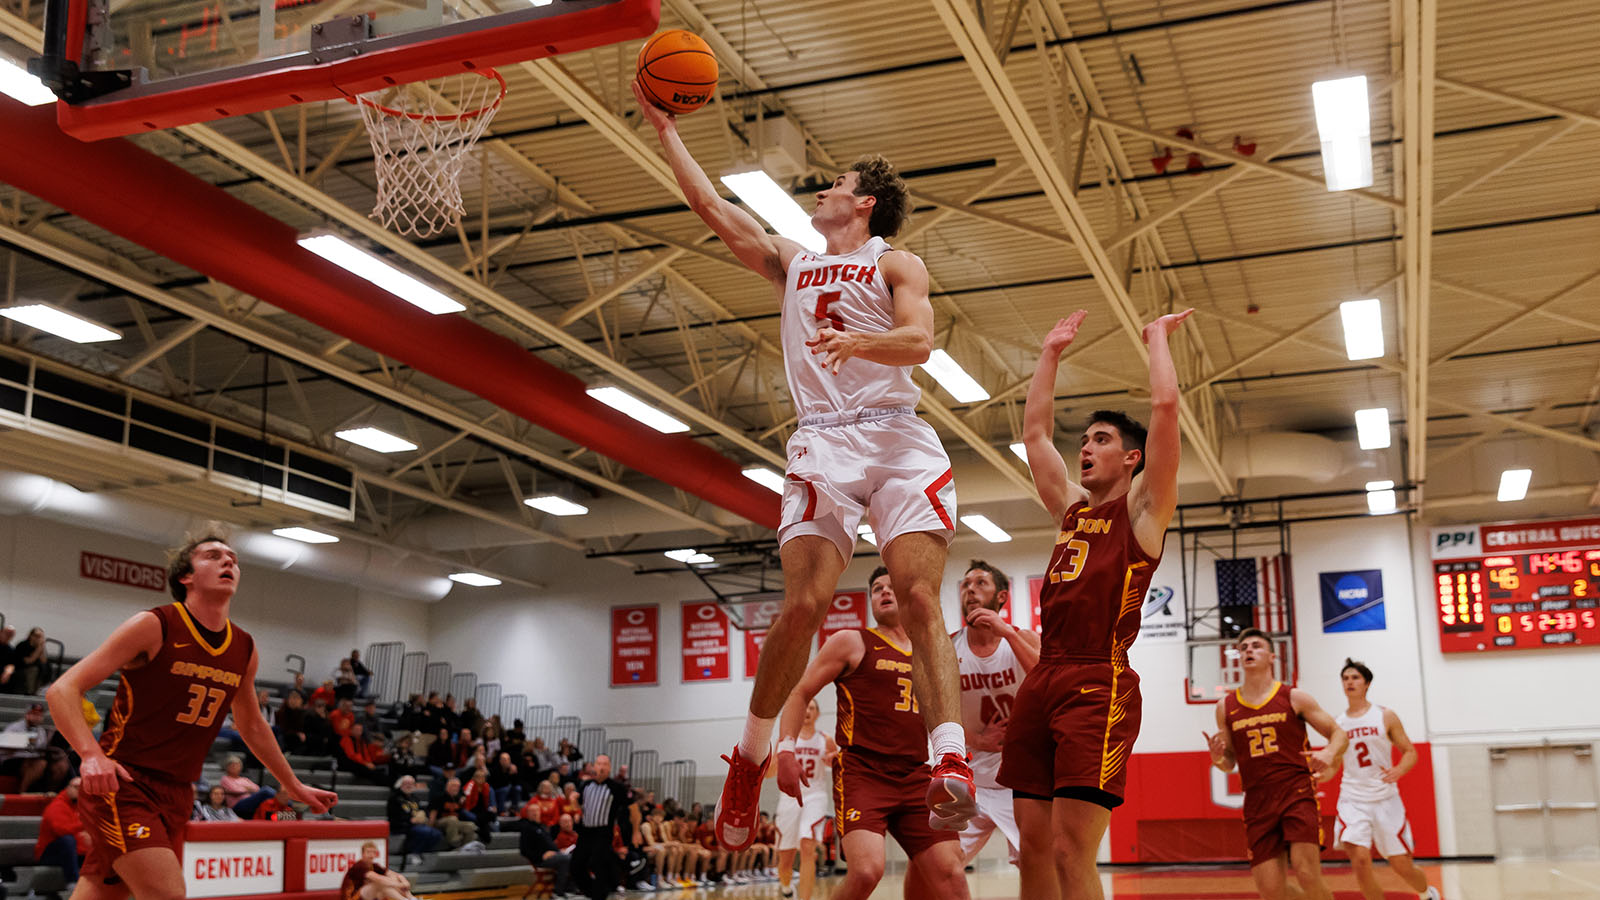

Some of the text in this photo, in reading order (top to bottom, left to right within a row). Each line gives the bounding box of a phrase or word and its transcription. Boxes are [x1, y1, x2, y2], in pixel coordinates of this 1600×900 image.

[796, 264, 876, 290] DUTCH
[815, 291, 845, 331] 5
[857, 407, 914, 418] RMOUR
[1437, 532, 1475, 546] PPI
[1486, 530, 1557, 546] CENTRAL
[83, 555, 164, 589] VISITORS
[1490, 567, 1520, 590] 46
[1573, 579, 1588, 597] 2
[1498, 615, 1512, 633] 0
[170, 661, 242, 688] SIMPSON
[875, 659, 912, 673] SIMP
[960, 668, 1016, 691] DUTCH
[176, 683, 227, 727] 33
[895, 677, 919, 714] 3
[1232, 713, 1287, 731] SIMPSON
[1346, 726, 1379, 740] UTCH
[1247, 727, 1279, 758] 22
[1355, 742, 1372, 768] 2
[195, 853, 358, 880] CENTRAL DUTCH
